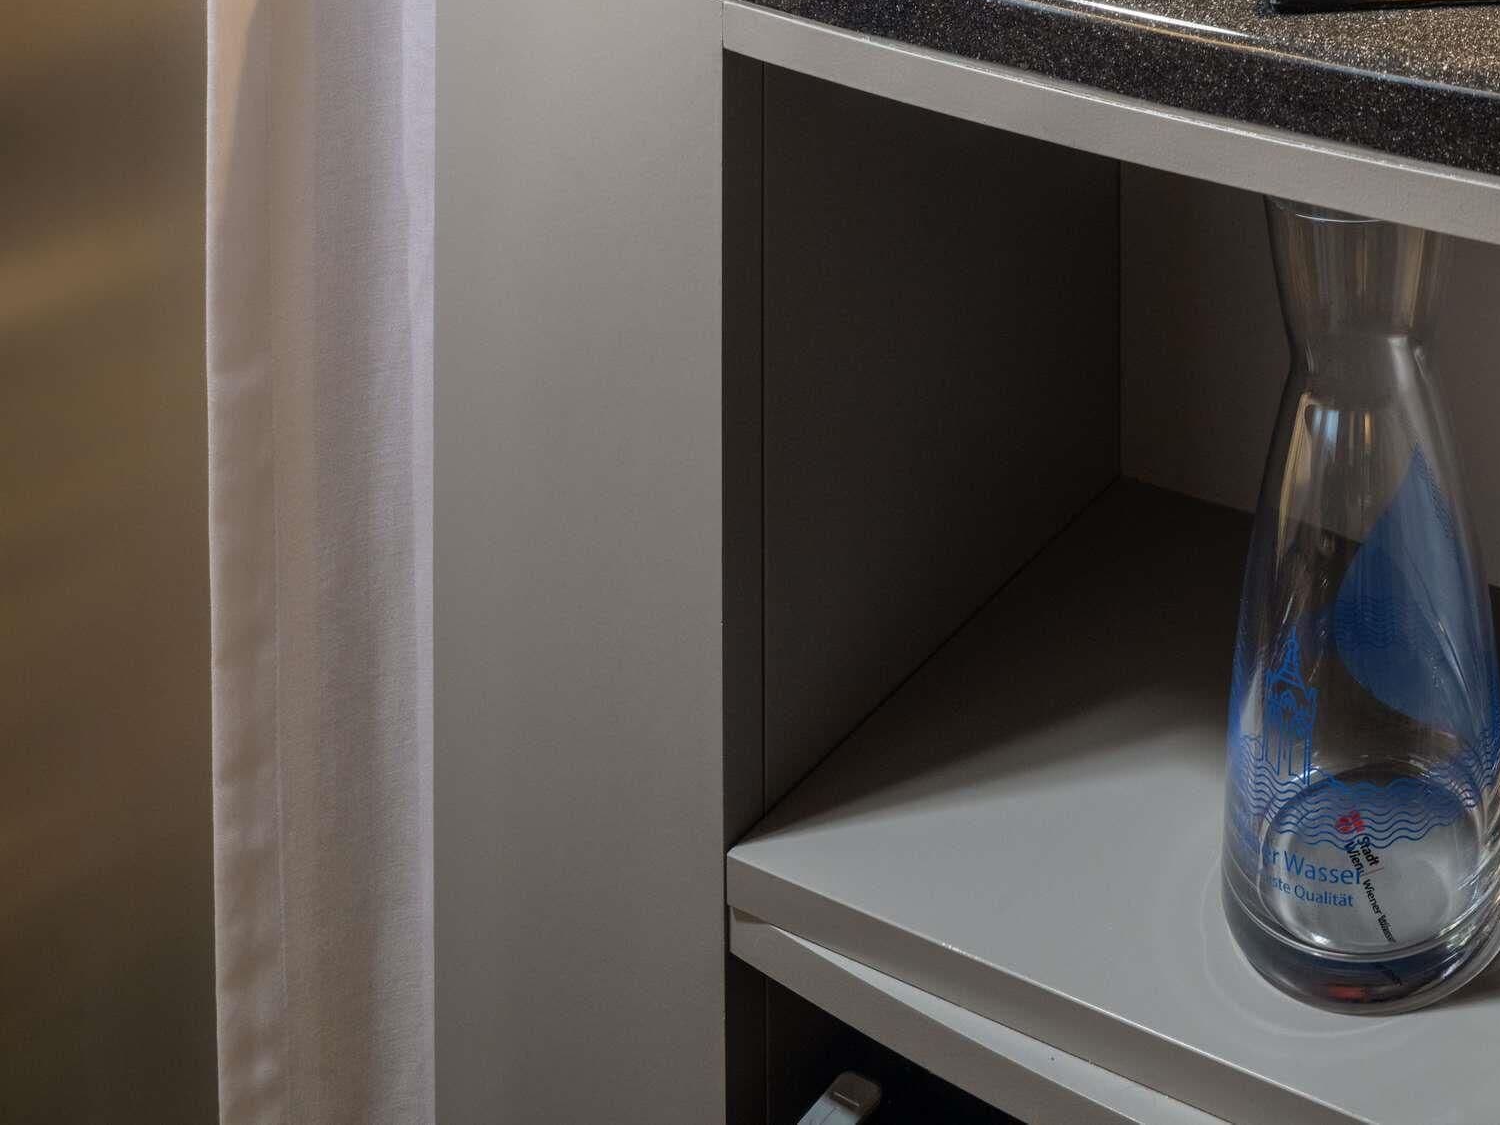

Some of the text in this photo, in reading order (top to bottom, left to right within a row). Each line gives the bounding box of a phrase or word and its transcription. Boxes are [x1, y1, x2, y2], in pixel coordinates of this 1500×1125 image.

[1344, 841, 1364, 873] Wien
[1357, 836, 1380, 866] Stadt
[1284, 851, 1360, 884] Wasser
[1294, 884, 1354, 907] Qualität
[1363, 879, 1382, 915] Wiener
